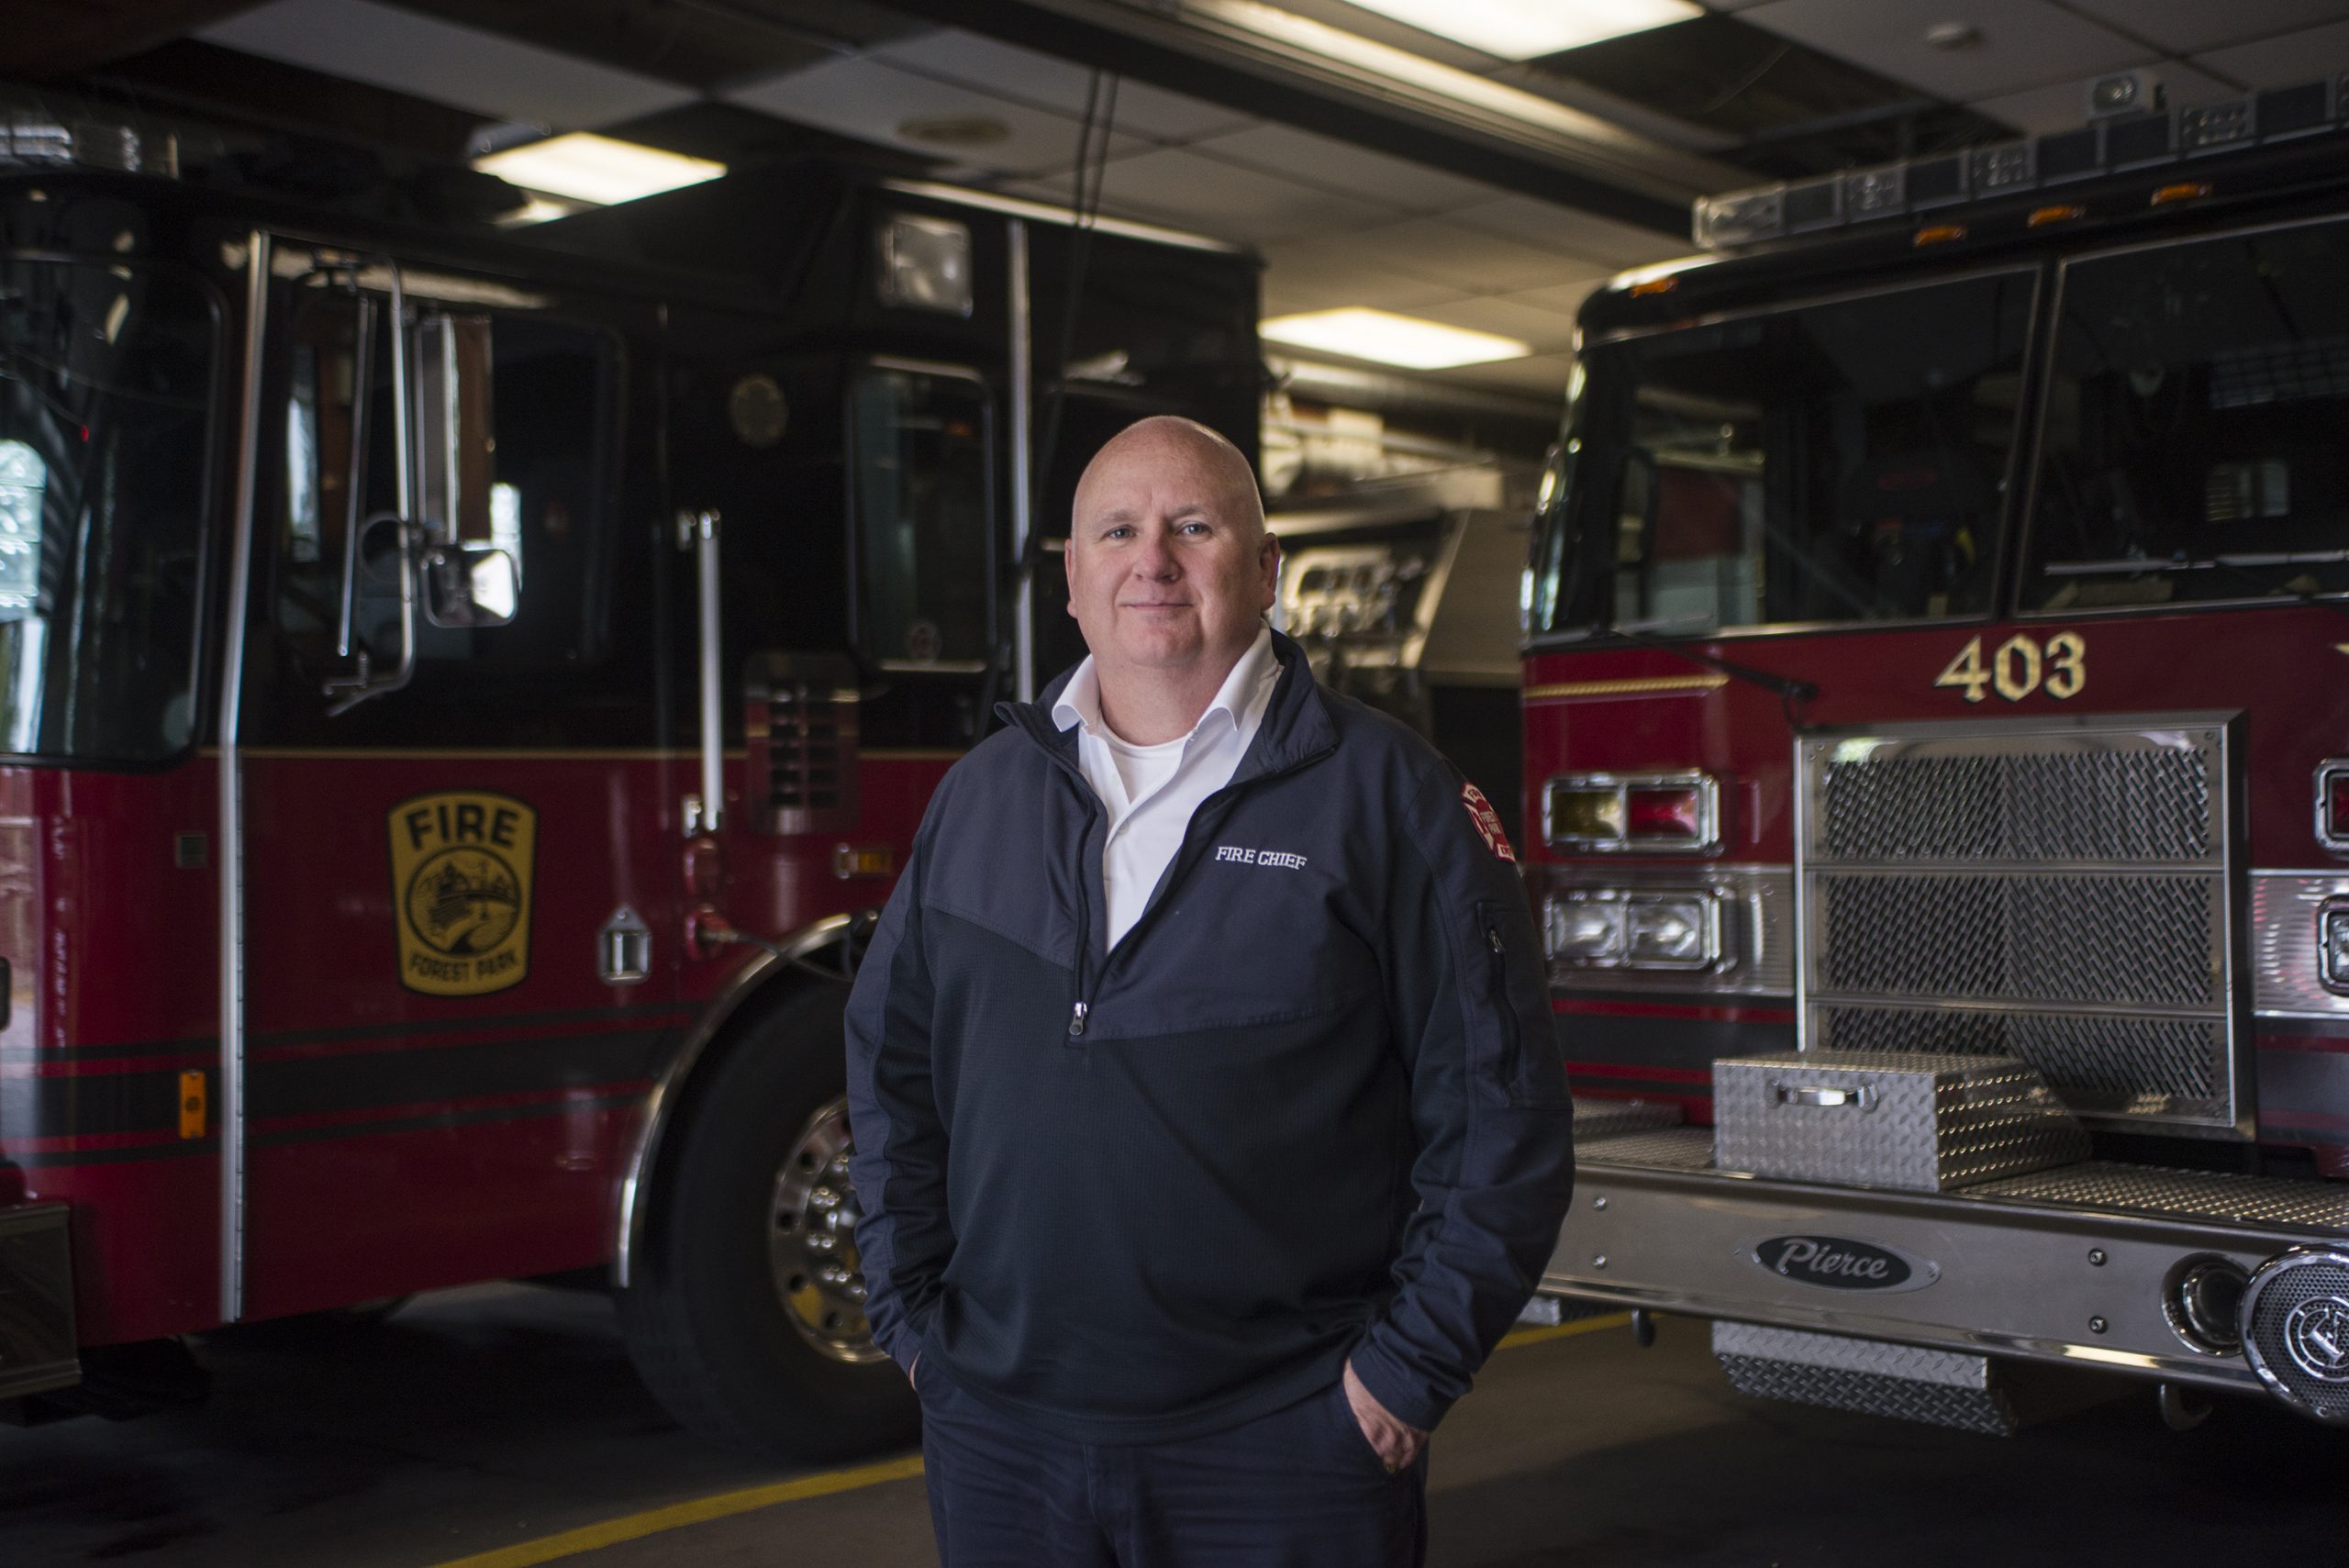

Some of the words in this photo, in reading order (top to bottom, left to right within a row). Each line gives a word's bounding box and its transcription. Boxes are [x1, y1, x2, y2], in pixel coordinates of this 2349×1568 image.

[1934, 630, 2087, 704] 403
[405, 804, 519, 851] FIRE
[1215, 846, 1255, 865] FIRE
[1257, 851, 1308, 871] CHIEF
[1777, 1239, 1889, 1279] Pierce
